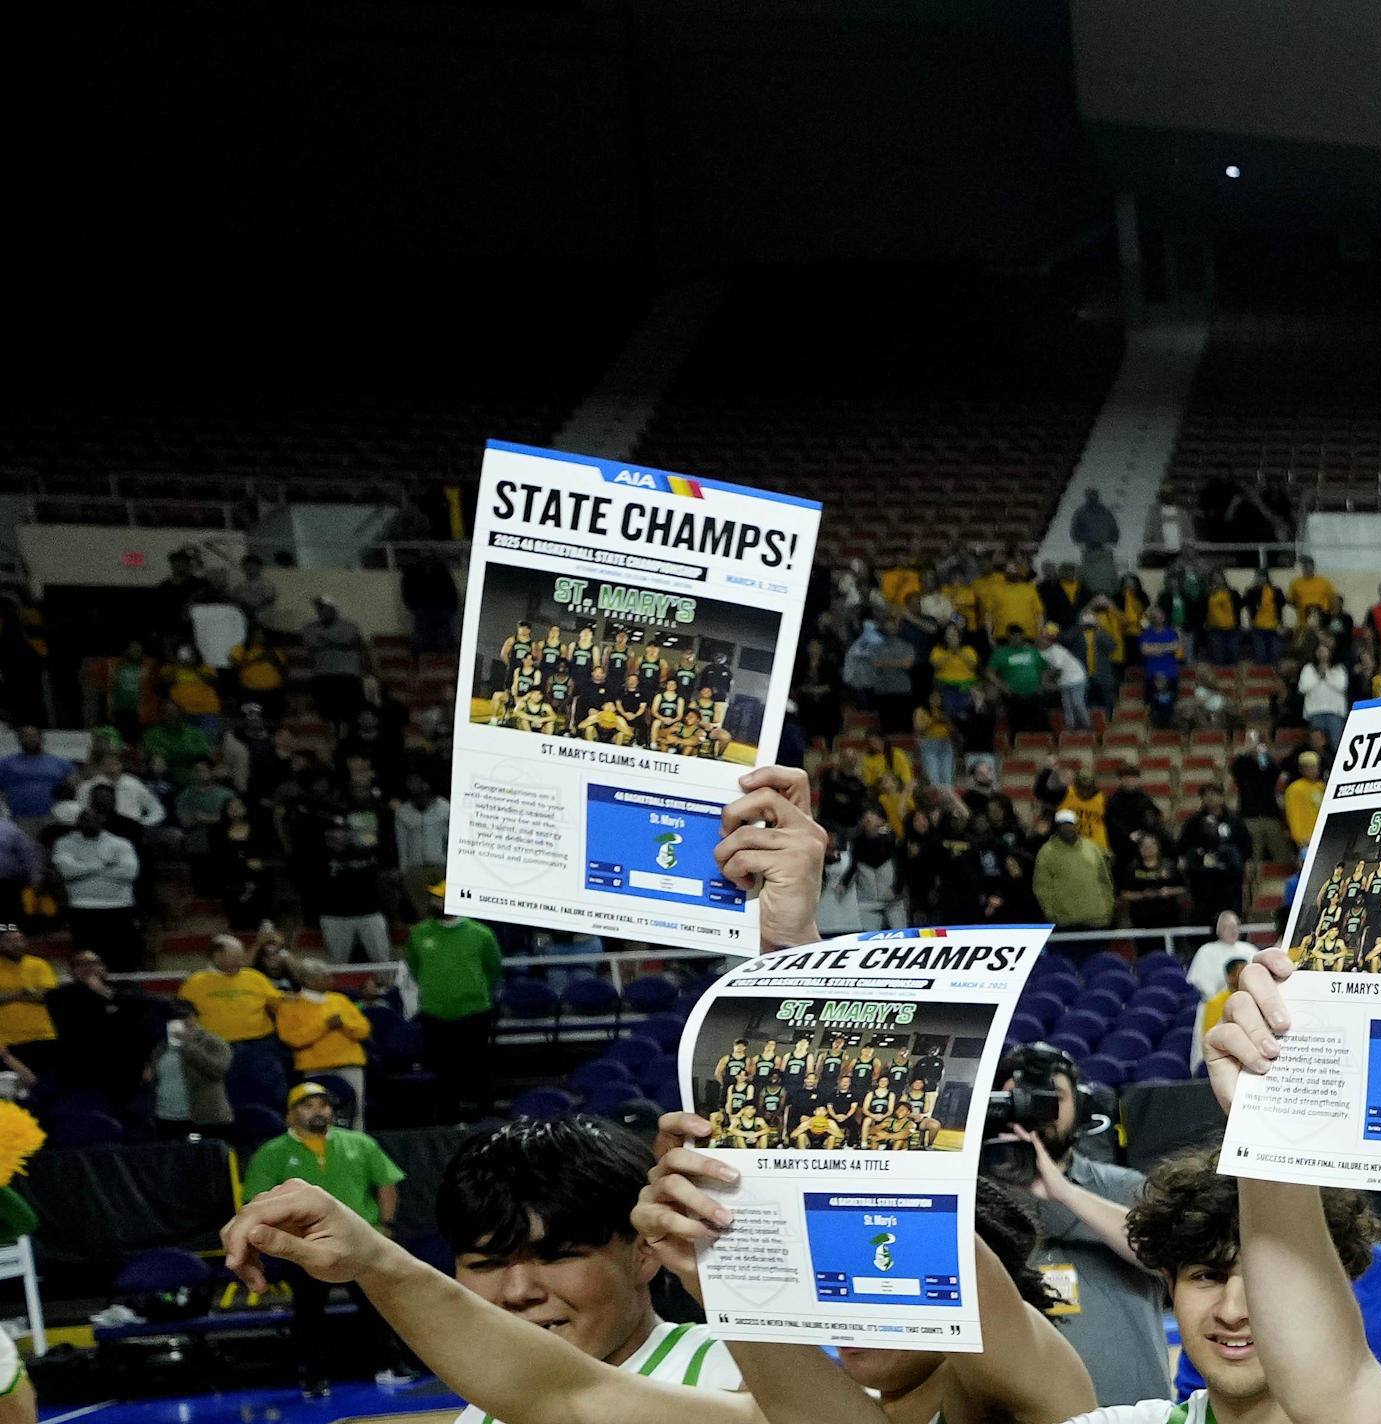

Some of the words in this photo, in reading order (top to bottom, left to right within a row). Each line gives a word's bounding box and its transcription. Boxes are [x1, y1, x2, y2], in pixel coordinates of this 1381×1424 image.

[613, 469, 657, 489] AIA
[493, 480, 615, 536] STATE
[620, 501, 799, 570] CHAMPS!
[554, 577, 593, 606] ST.
[597, 582, 697, 624] MARY'S
[869, 931, 904, 941] AIA
[744, 947, 859, 974] STATE
[860, 945, 1027, 973] CHAMPS!
[1330, 981, 1343, 993] ST.
[1345, 982, 1379, 995] MARY'S
[776, 999, 815, 1021] ST.
[819, 1000, 917, 1024] MARY'S
